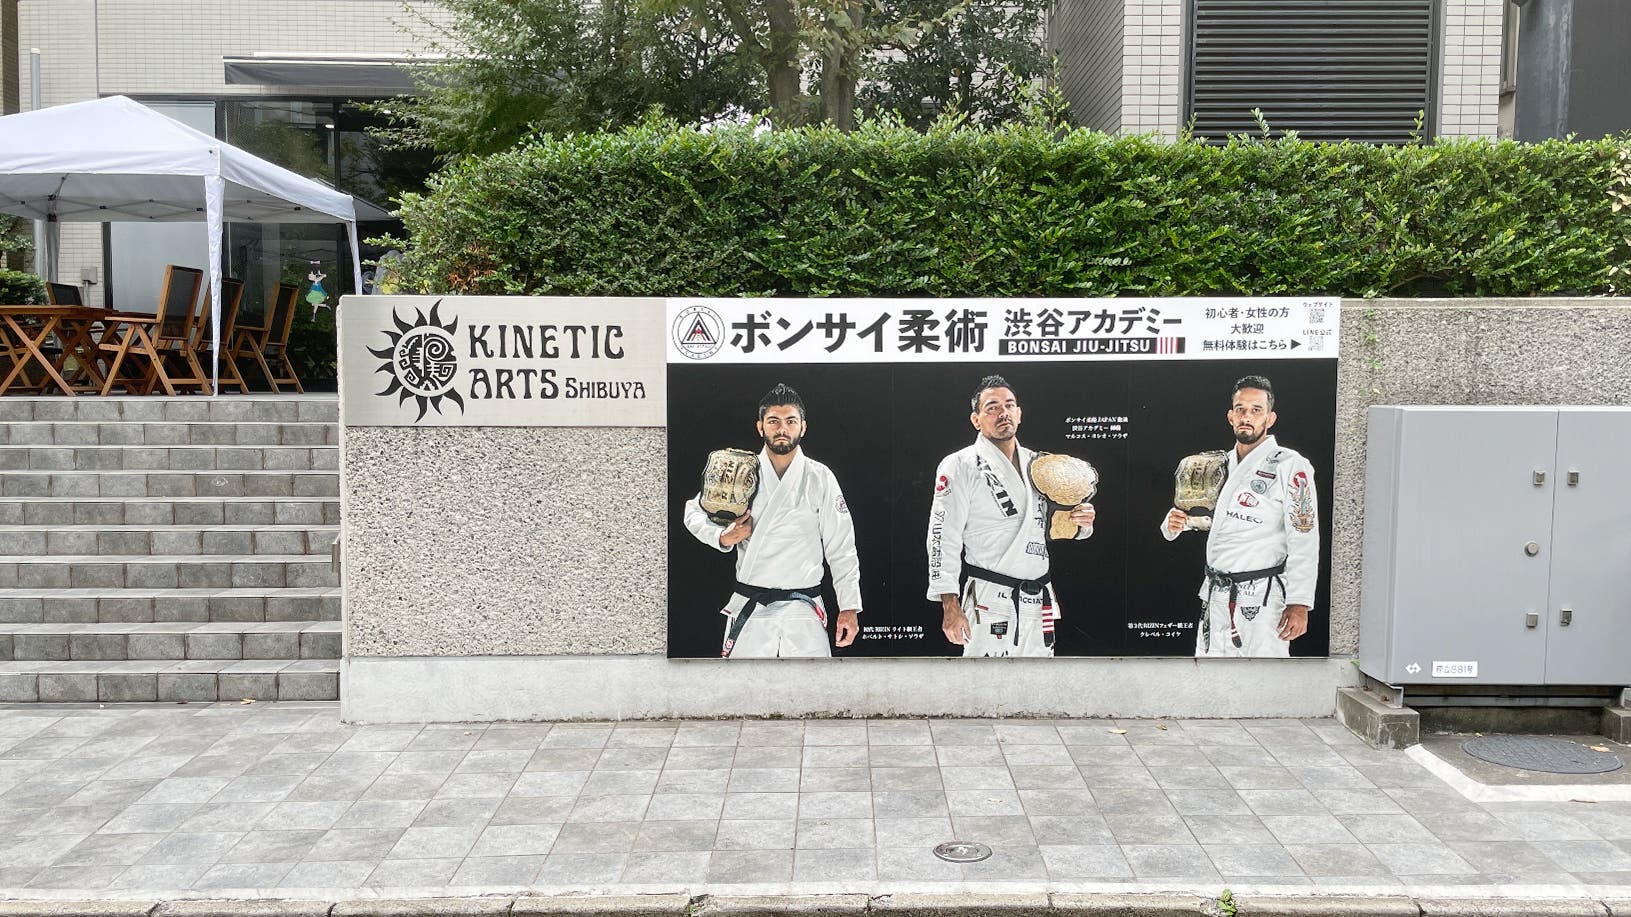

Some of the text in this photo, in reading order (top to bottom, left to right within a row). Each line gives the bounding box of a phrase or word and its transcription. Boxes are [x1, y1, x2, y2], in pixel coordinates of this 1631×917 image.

[1004, 307, 1182, 337] 渋谷アカデミー
[1205, 306, 1290, 319] 初心者・女性の方
[730, 309, 988, 353] ボンサイ柔術
[1230, 323, 1264, 335] 大歓迎
[468, 325, 625, 359] KINETIC
[1007, 340, 1150, 353] BONSAI JIU-JITSU
[1202, 339, 1287, 351] 無料体験はこちら
[468, 368, 647, 400] ARTS SHIBUYA
